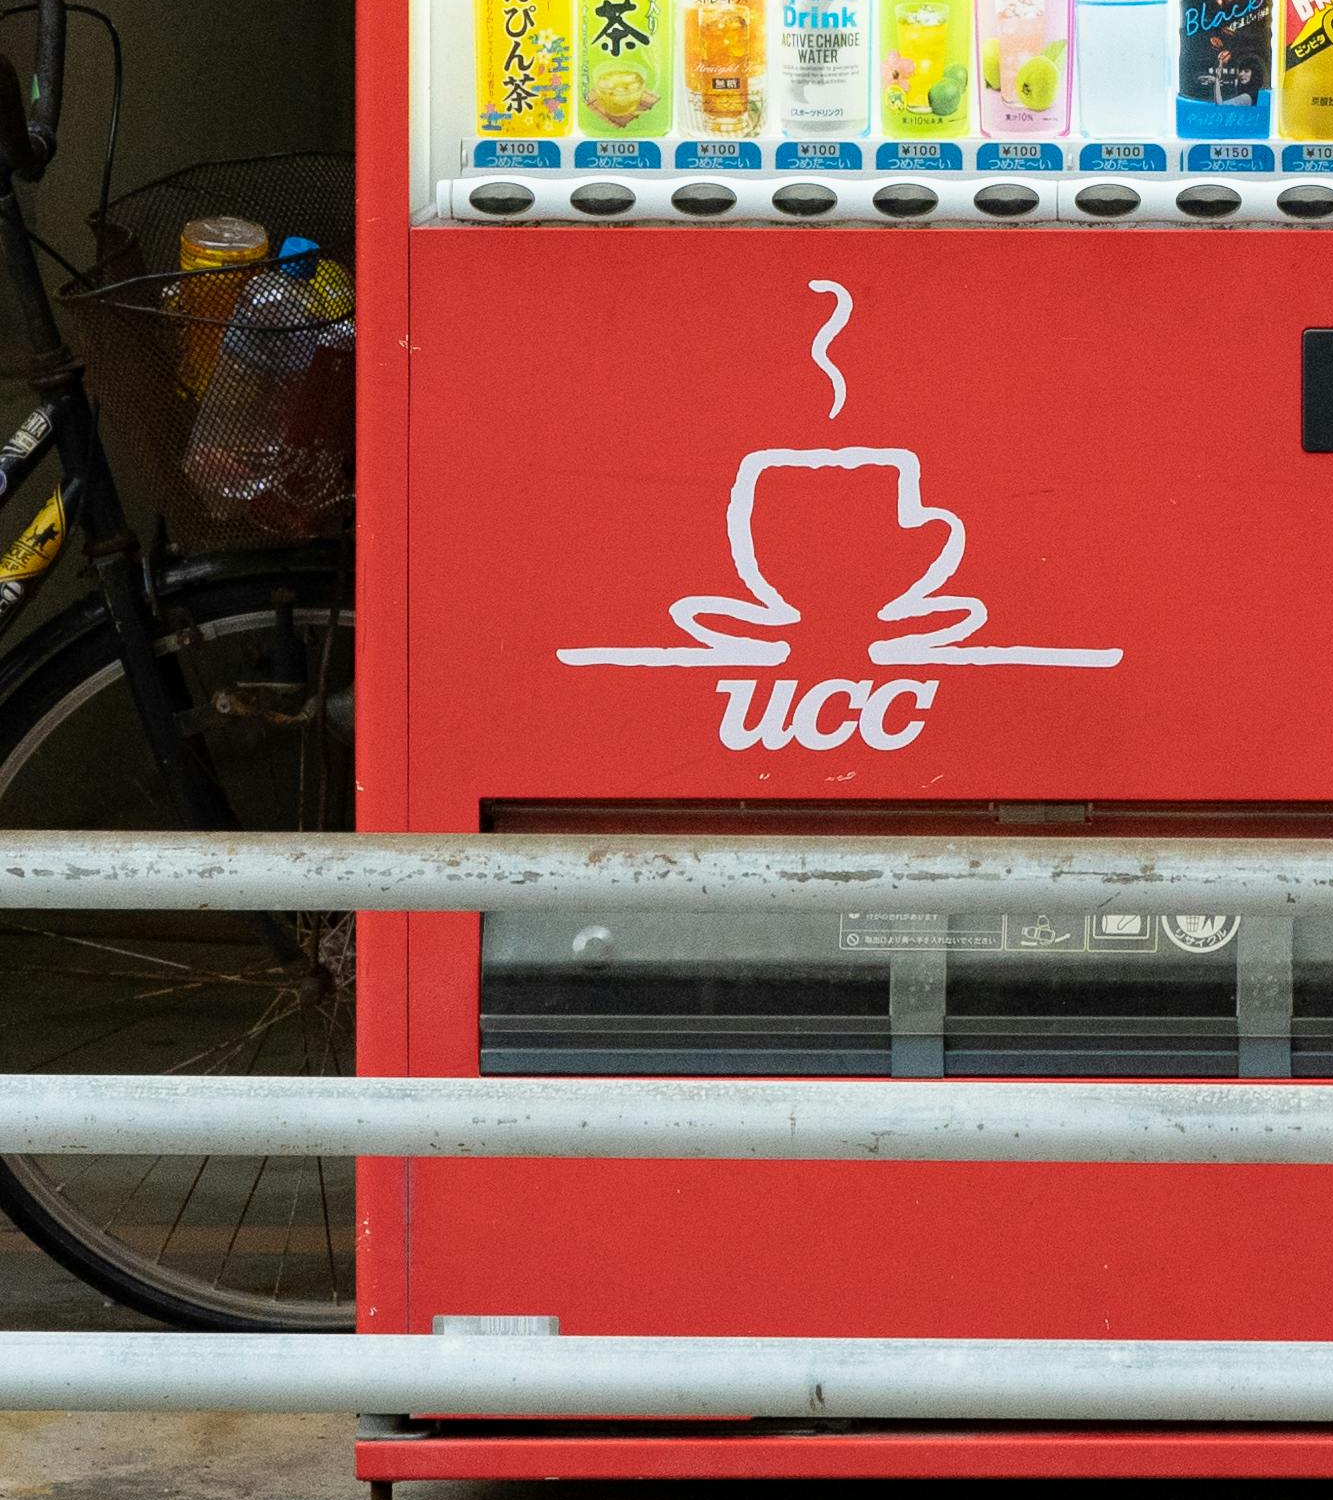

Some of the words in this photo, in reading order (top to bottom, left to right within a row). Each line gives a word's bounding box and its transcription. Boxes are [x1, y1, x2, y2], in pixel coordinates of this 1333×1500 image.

[783, 6, 857, 29] Drink
[782, 33, 815, 48] ACTIVE
[816, 32, 860, 48] CHANGE
[798, 48, 838, 64] WATER
[499, 143, 535, 155] ¥100
[1214, 147, 1249, 158] ¥150
[714, 678, 940, 750] ucc
